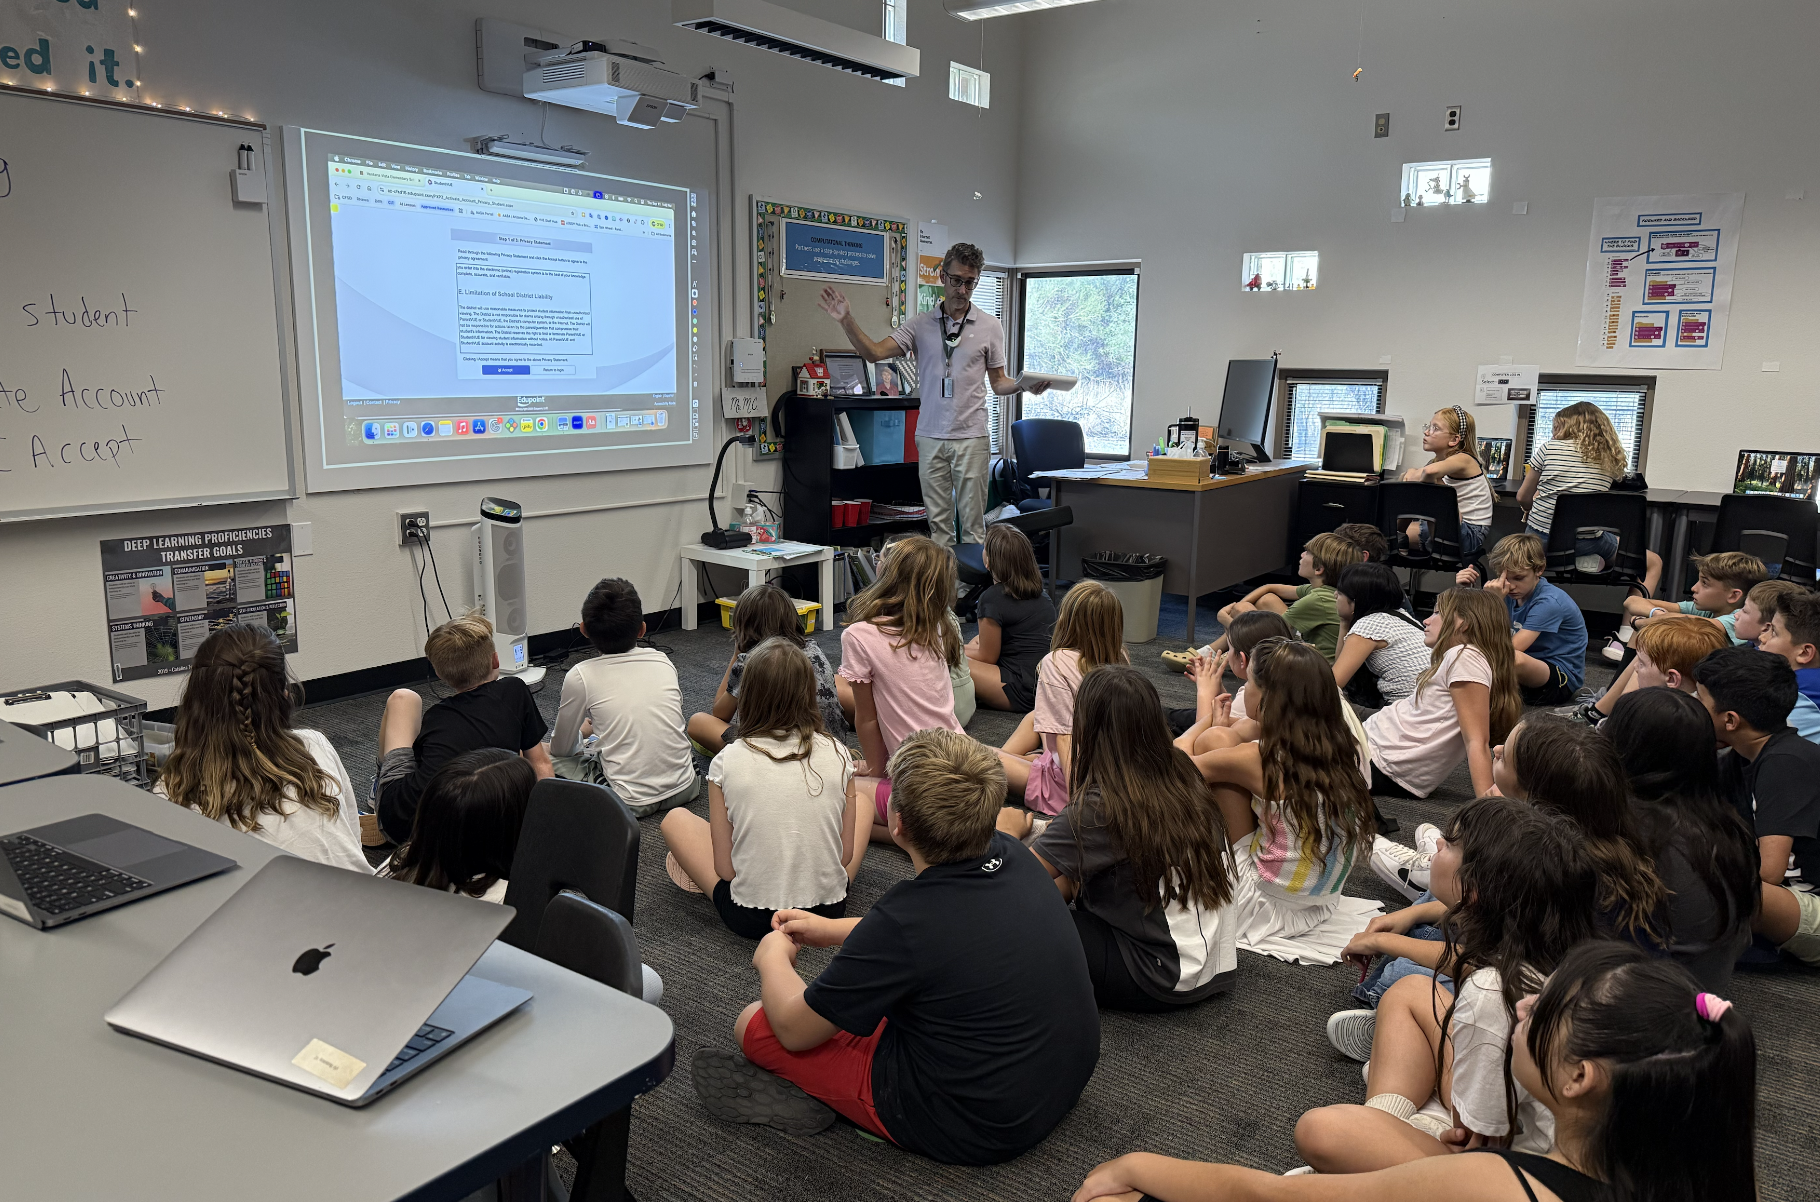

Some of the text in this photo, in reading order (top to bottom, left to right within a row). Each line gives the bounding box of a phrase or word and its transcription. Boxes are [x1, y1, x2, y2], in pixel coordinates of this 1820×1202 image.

[85, 45, 134, 88] it.
[795, 243, 812, 252] Partners
[810, 237, 844, 246] COMPUTATIONAL
[919, 263, 941, 277] Stron
[534, 293, 553, 301] Liability
[919, 293, 935, 306] Kind
[60, 368, 165, 409] Account
[31, 424, 142, 468] Accept
[124, 528, 273, 552] DEEP LEARNING PROFICIENCIES
[161, 544, 243, 563] TRANSFER GOALS
[174, 566, 209, 574] COMMUNICATION
[111, 624, 132, 632] SYSTEMS
